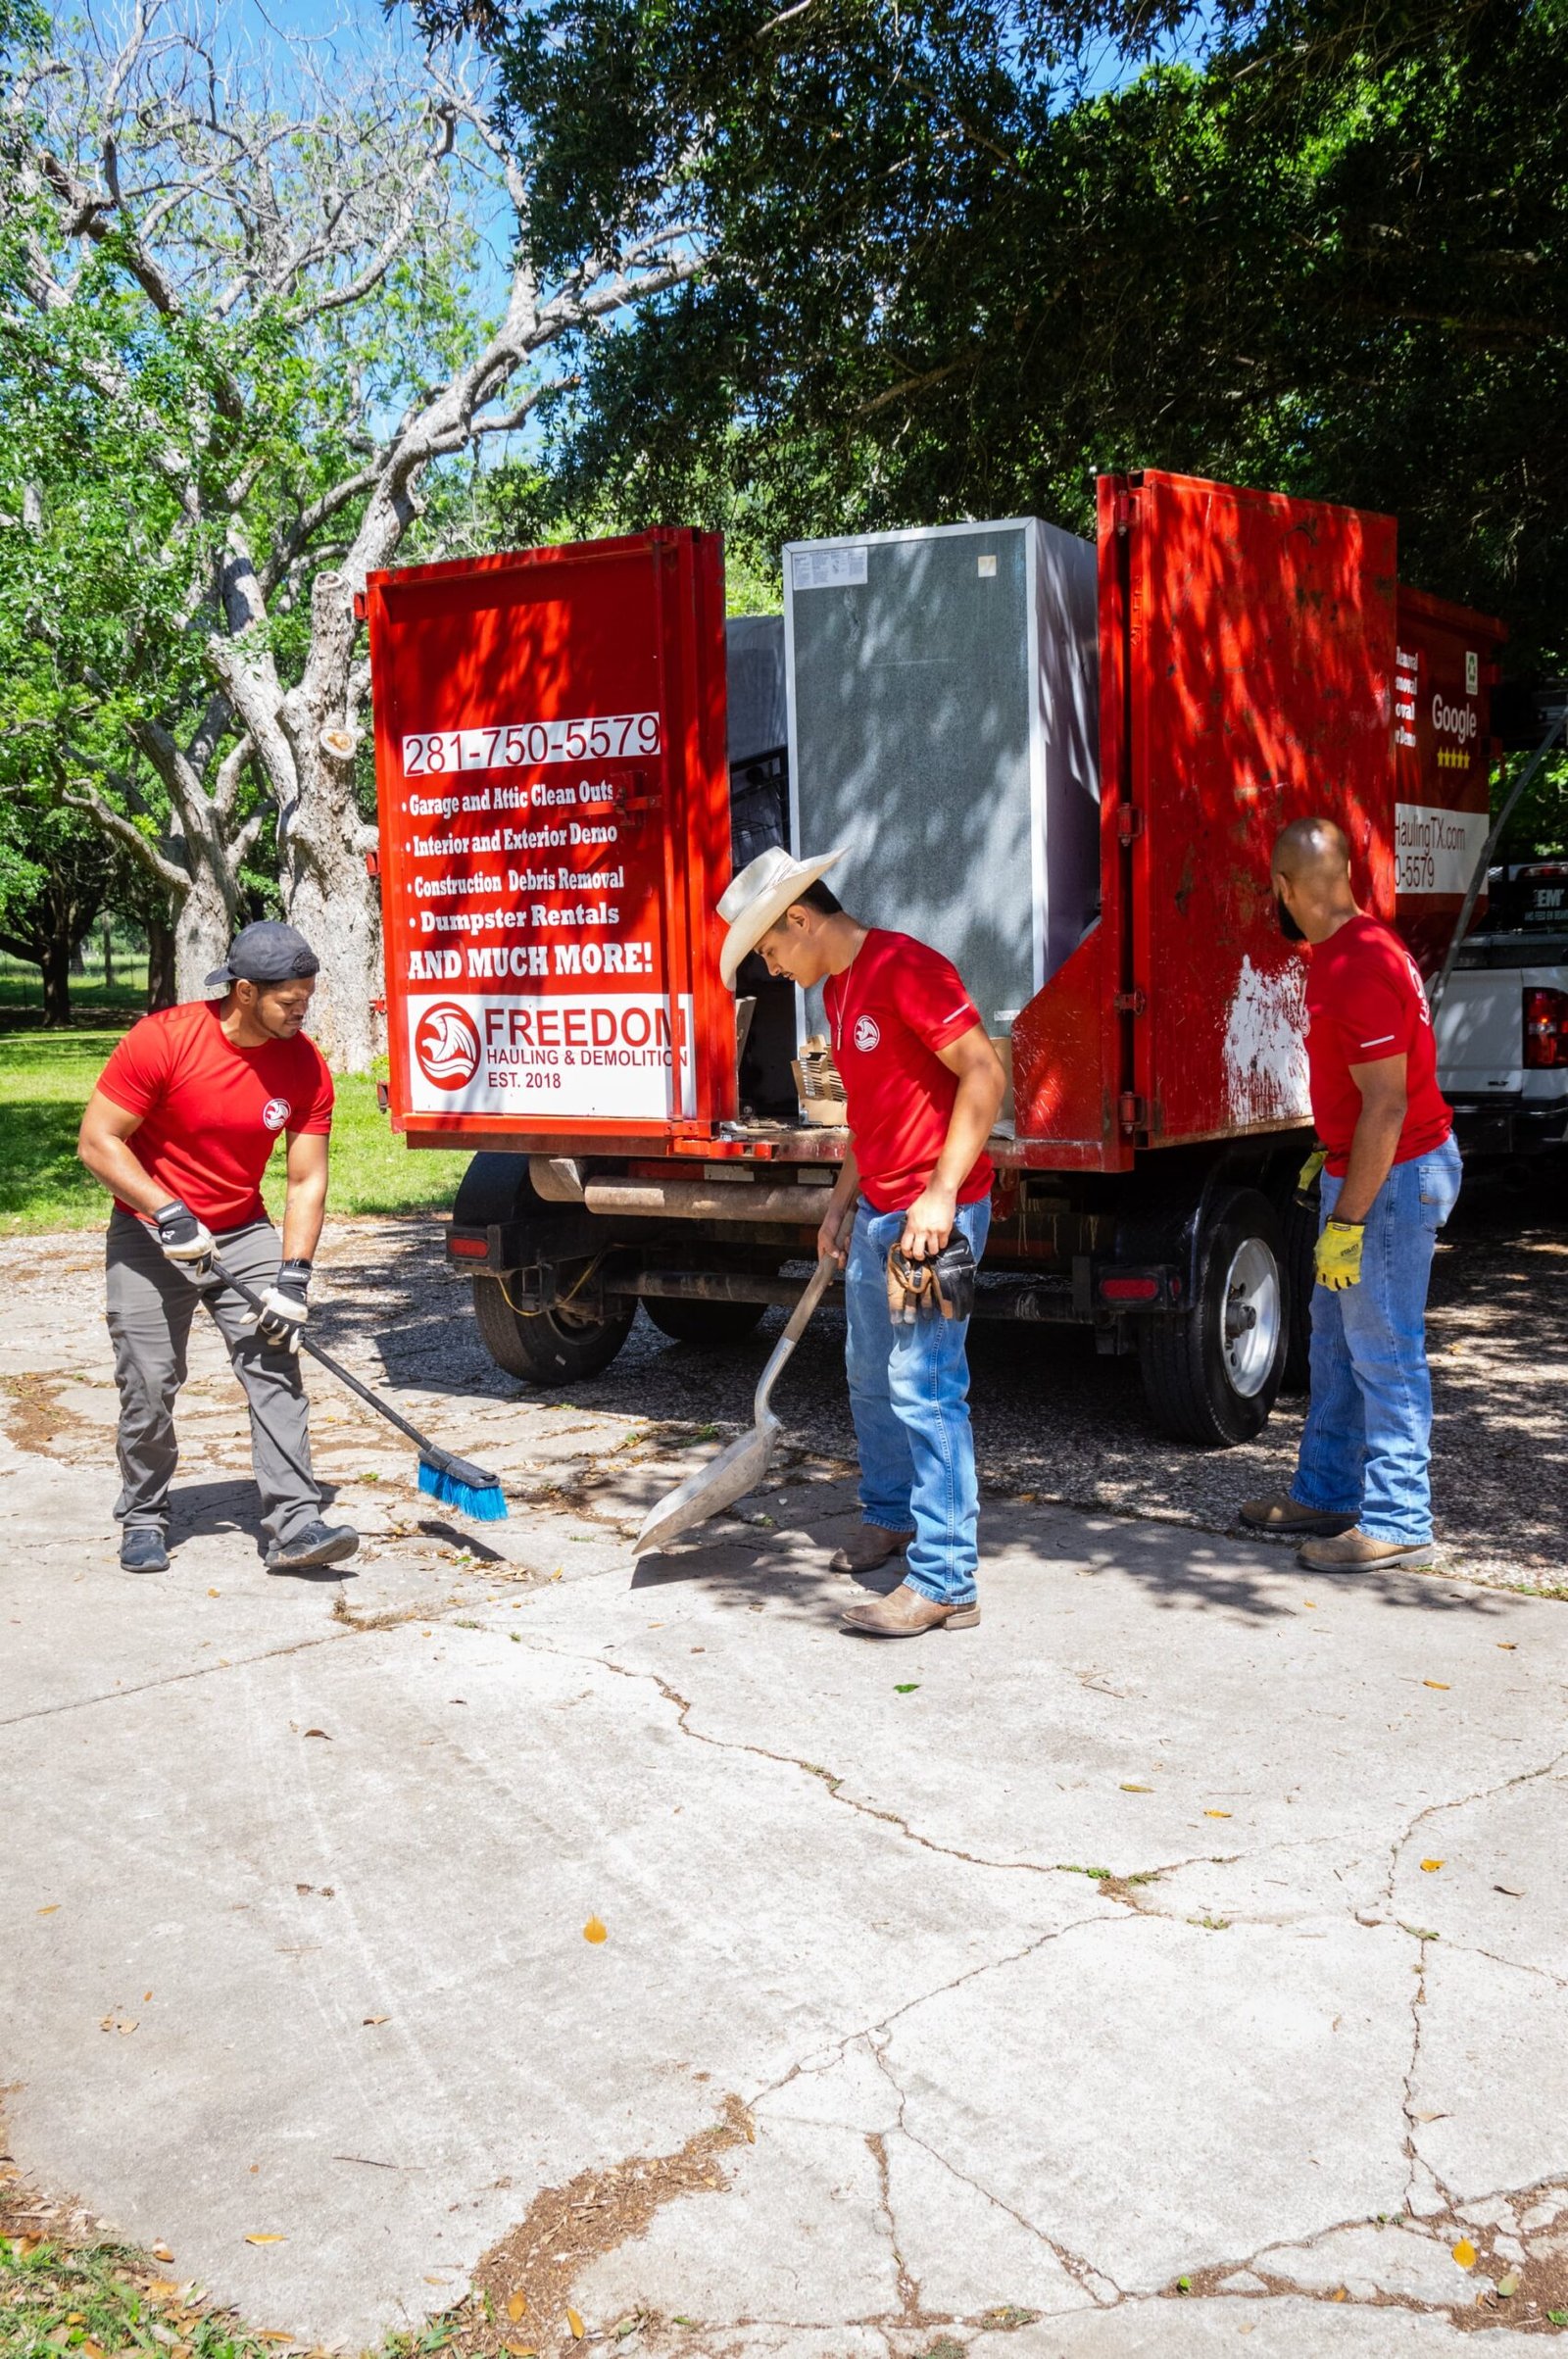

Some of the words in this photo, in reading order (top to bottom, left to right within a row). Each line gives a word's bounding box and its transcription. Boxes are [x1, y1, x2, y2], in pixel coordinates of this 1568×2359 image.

[1432, 693, 1477, 744] Google
[406, 715, 660, 776] 281-750-5579
[409, 794, 460, 819] Garage
[463, 789, 490, 811] and
[493, 786, 528, 810] Attic
[531, 783, 576, 806] Clean
[579, 779, 613, 803] Outs
[413, 833, 469, 858] Interior
[471, 829, 501, 852] and
[503, 824, 567, 851] Exterior
[569, 822, 618, 845] Demo
[415, 870, 502, 898] Construction
[509, 866, 556, 892] Debris
[558, 865, 624, 891] Removal
[420, 908, 526, 936] Dumpster
[530, 902, 619, 926] Rentals
[408, 949, 463, 980] AND
[467, 945, 548, 978] MUCH
[554, 941, 653, 975] MORE!
[484, 1007, 686, 1048] FREEDOM
[486, 1049, 559, 1065] HAULING
[564, 1050, 576, 1065] &
[488, 1071, 521, 1088] EST.
[525, 1072, 562, 1089] 2018
